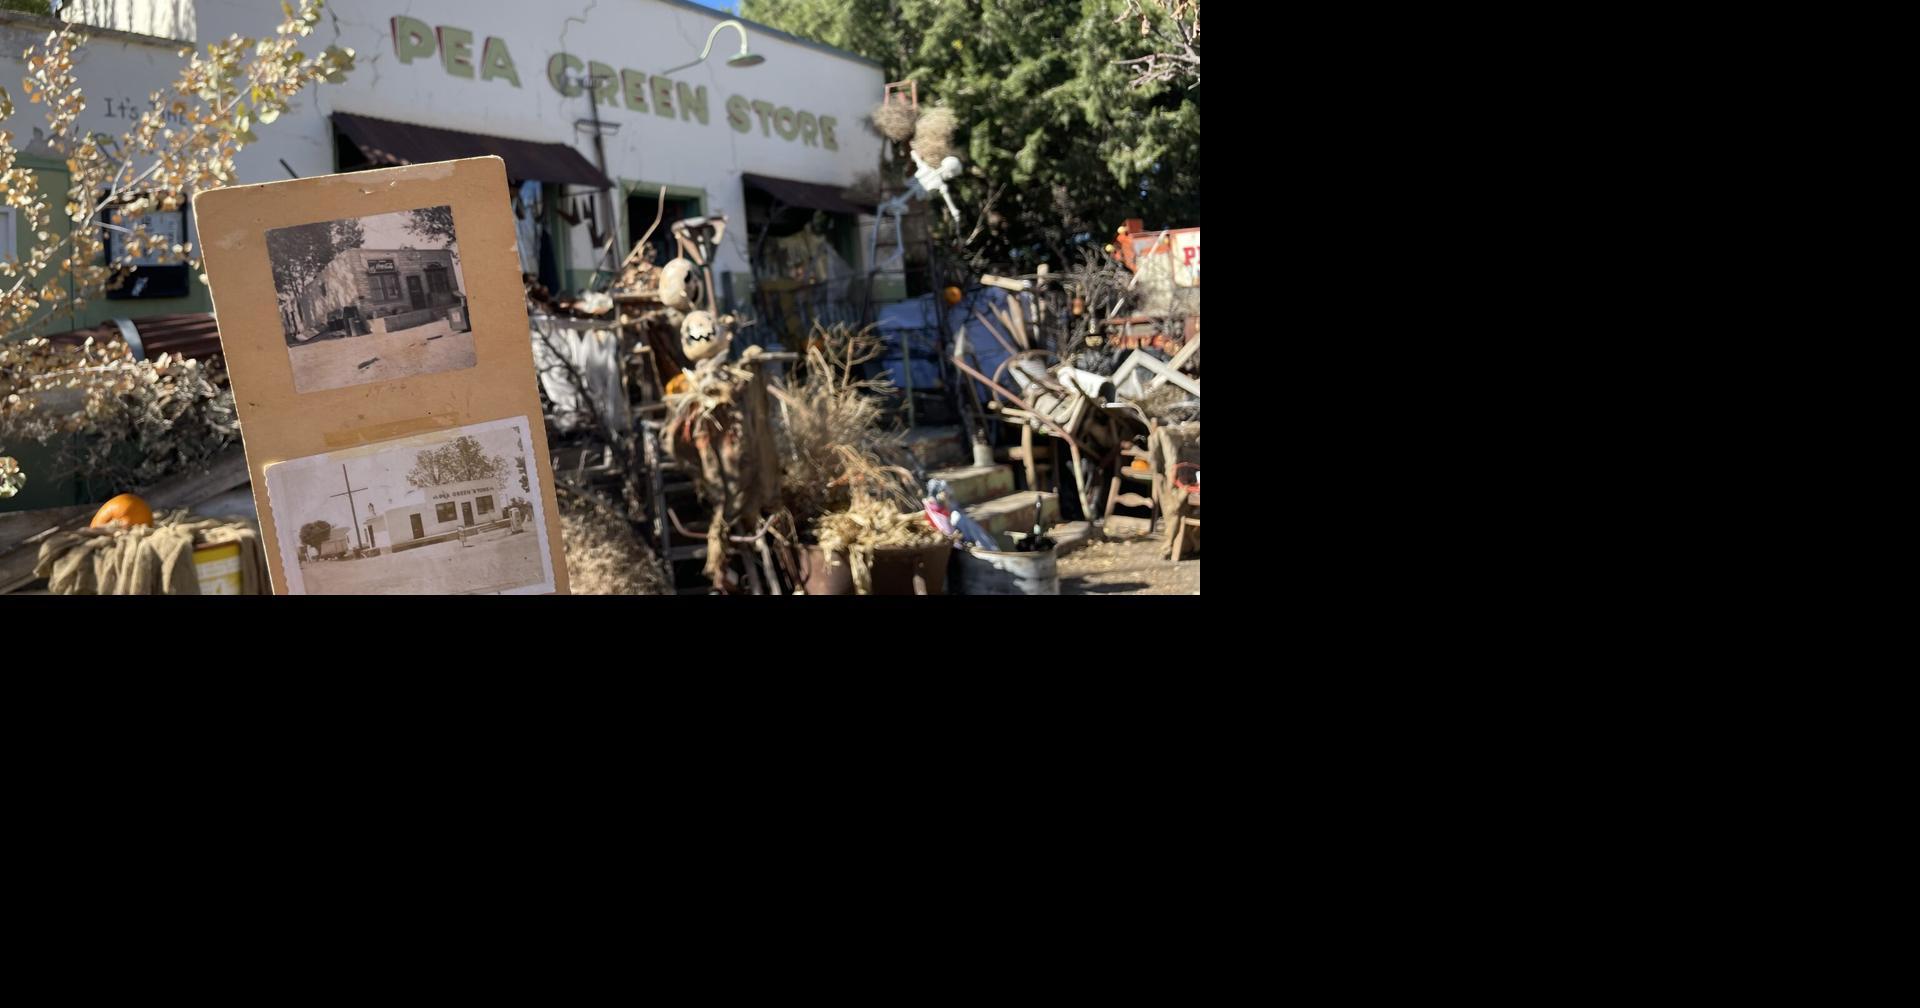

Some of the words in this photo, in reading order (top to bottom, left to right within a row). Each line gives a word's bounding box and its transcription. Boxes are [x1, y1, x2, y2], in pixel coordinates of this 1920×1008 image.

[104, 97, 139, 121] It's
[390, 15, 521, 88] PEA
[547, 52, 710, 126] GREEN
[725, 94, 839, 151] STORE
